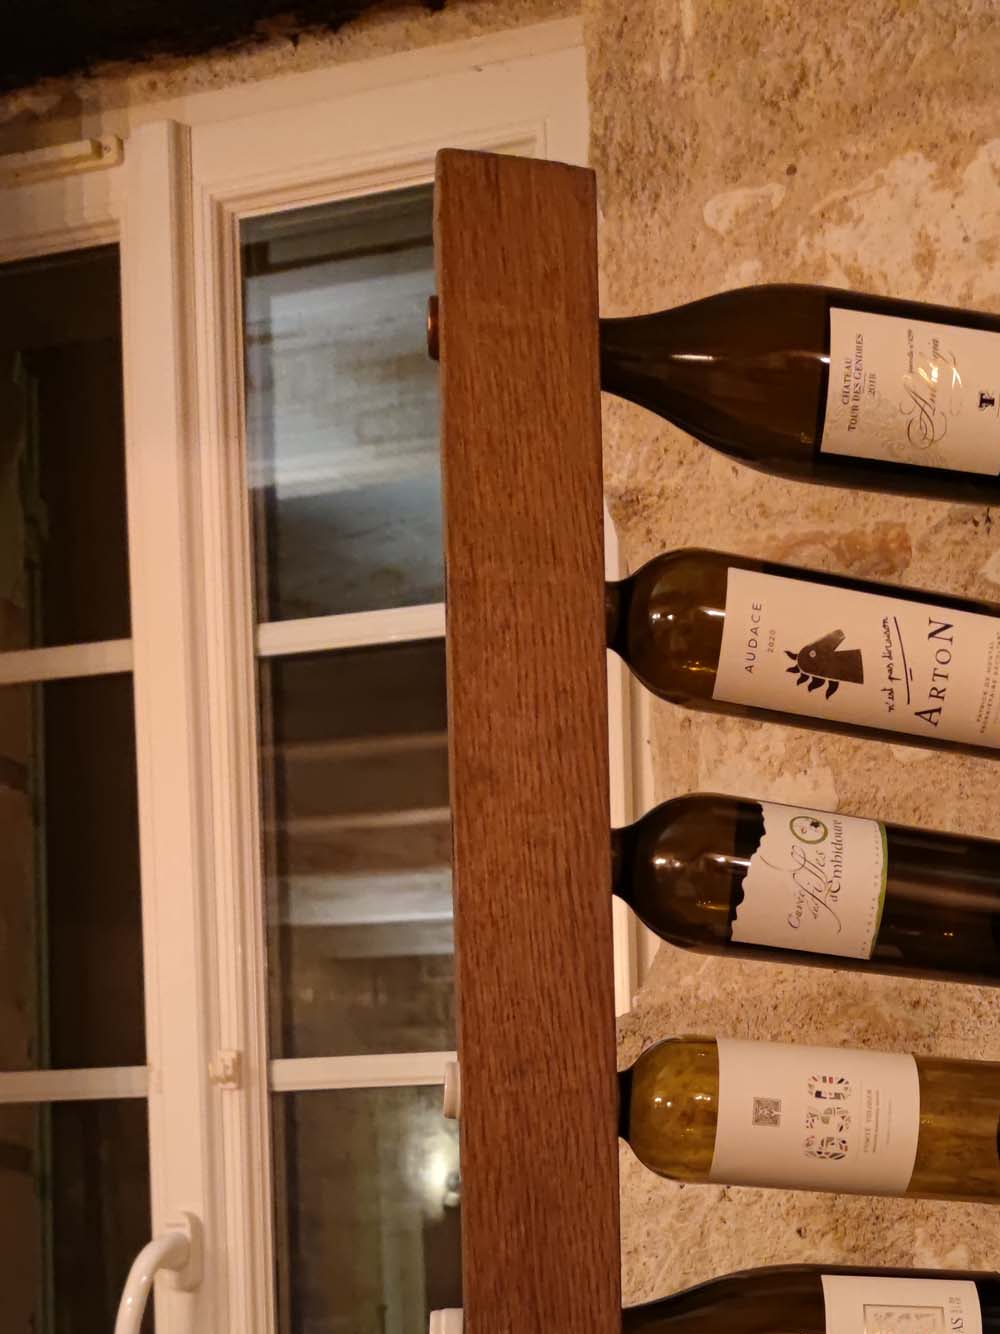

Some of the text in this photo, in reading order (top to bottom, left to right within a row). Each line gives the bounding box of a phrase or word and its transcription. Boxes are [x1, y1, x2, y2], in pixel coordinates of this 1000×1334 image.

[848, 334, 863, 431] TOUR DES GENDRES
[744, 602, 762, 674] AUDACE
[767, 629, 776, 653] 2020
[887, 663, 902, 685] pas
[913, 616, 954, 727] ARTON
